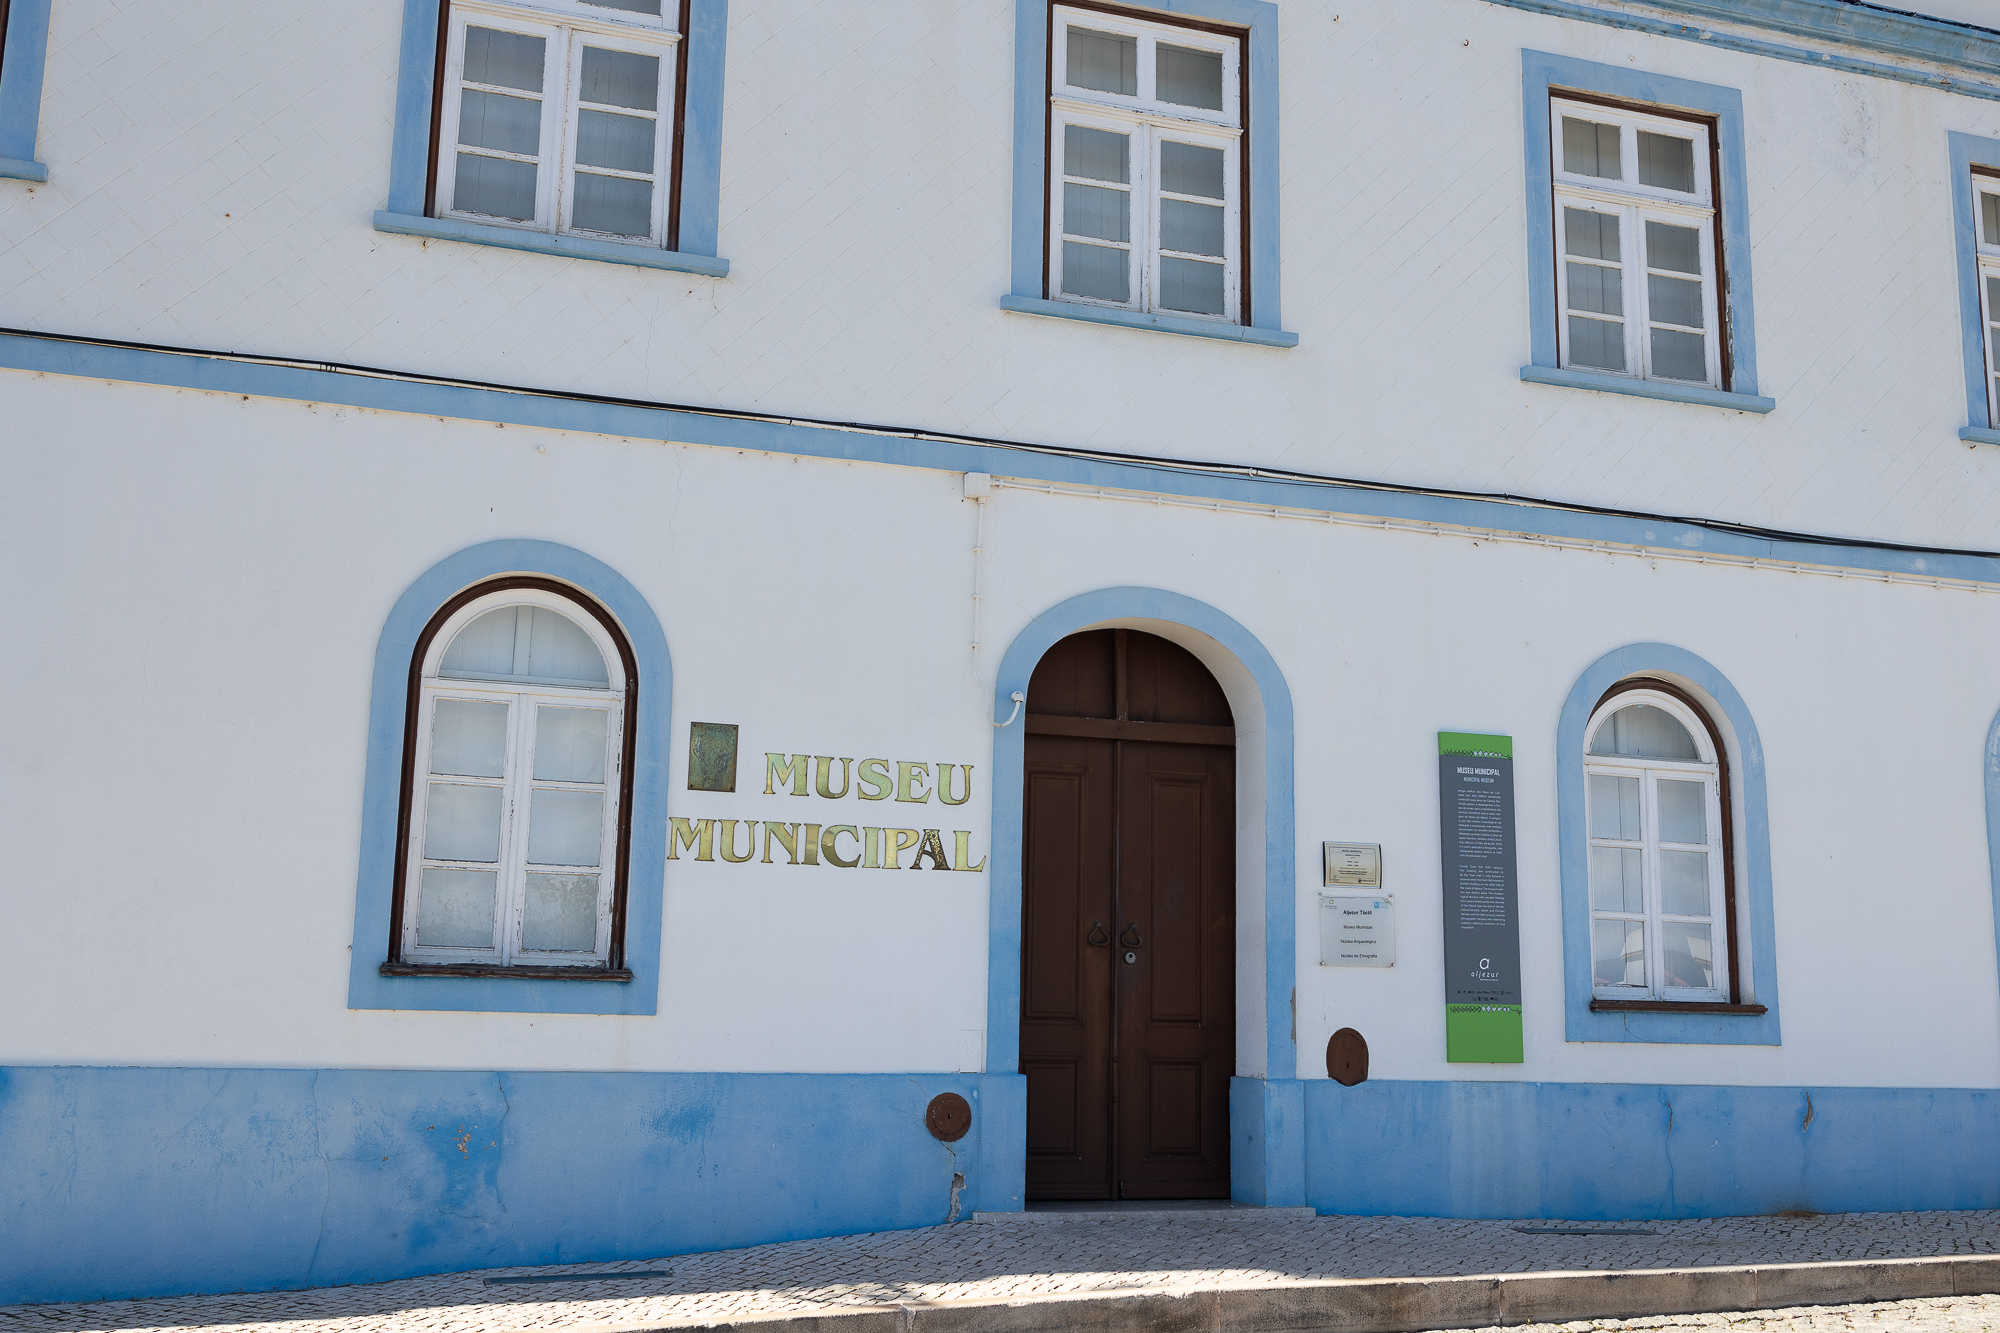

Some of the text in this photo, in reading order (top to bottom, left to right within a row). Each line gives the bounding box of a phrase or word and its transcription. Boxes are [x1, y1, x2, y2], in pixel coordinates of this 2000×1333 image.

[763, 752, 975, 806] MUSEU
[1457, 767, 1500, 776] MUSEU MUNICIPAL
[666, 816, 987, 872] MUNICIPAL
